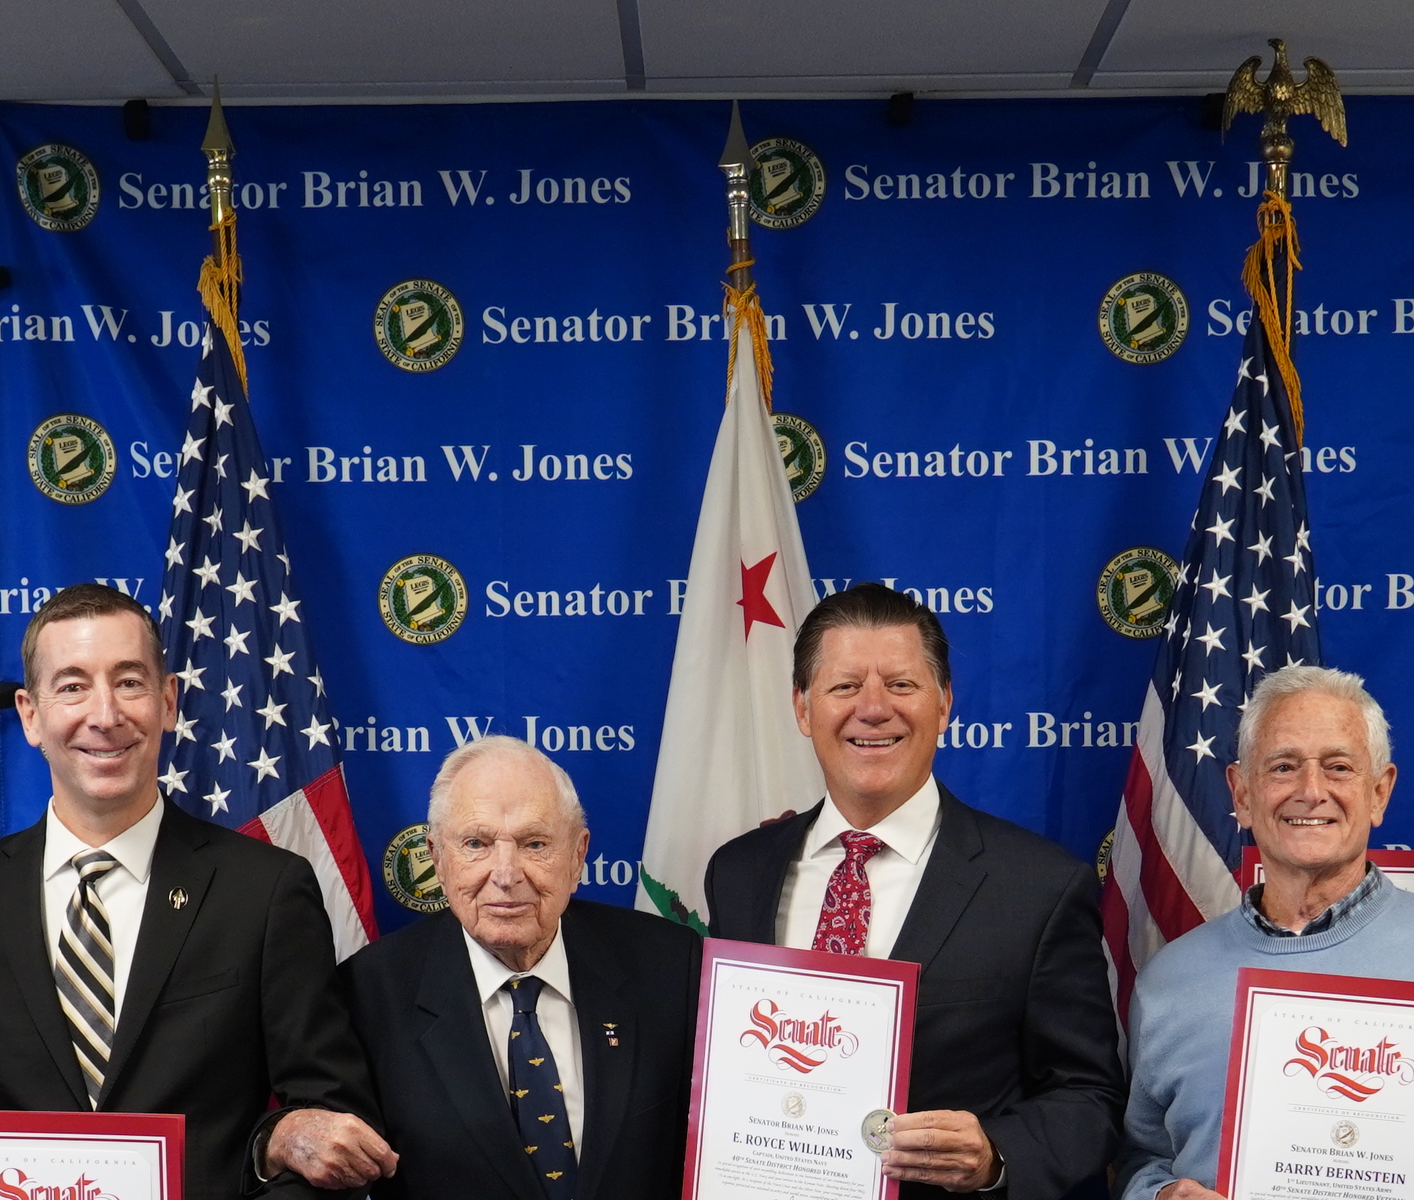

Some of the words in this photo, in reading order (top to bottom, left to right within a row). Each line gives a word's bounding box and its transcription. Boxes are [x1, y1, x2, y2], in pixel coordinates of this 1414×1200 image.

[303, 171, 422, 207] Brian
[439, 171, 494, 206] W.
[510, 170, 631, 204] Jones
[845, 165, 1014, 200] Senator
[1031, 162, 1150, 198] Brian
[1167, 162, 1222, 197] W.
[1238, 162, 1359, 198] Jnes
[376, 301, 390, 326] SEAL
[413, 281, 452, 302] SENATE
[1207, 299, 1377, 336] Seator
[81, 305, 136, 342] W.
[483, 307, 651, 343] Senator
[803, 304, 858, 340] W.
[874, 303, 994, 339] Jones
[378, 338, 401, 365] STATE
[411, 337, 461, 370] CALIFORNIA
[308, 447, 426, 482] Brian
[441, 446, 497, 481] W.
[513, 445, 632, 481] Jones
[845, 442, 1012, 477] Senator
[1027, 439, 1147, 475] Brian
[486, 581, 652, 617] Senator
[740, 999, 859, 1063] Senate
[748, 1115, 780, 1128] SENATOR
[781, 1120, 804, 1131] BRIAN
[805, 1124, 816, 1133] W.
[817, 1125, 839, 1137] JONES
[733, 1131, 742, 1144] E.
[745, 1134, 786, 1151] ROYCE
[788, 1140, 853, 1160] WILLIAMS
[1290, 1144, 1328, 1155] SENATOR
[1329, 1147, 1355, 1158] BRIAN
[1356, 1150, 1368, 1159] W.
[1369, 1151, 1394, 1162] JONES
[1275, 1161, 1323, 1177] BARRY
[1326, 1166, 1406, 1185] BERNSTEIN
